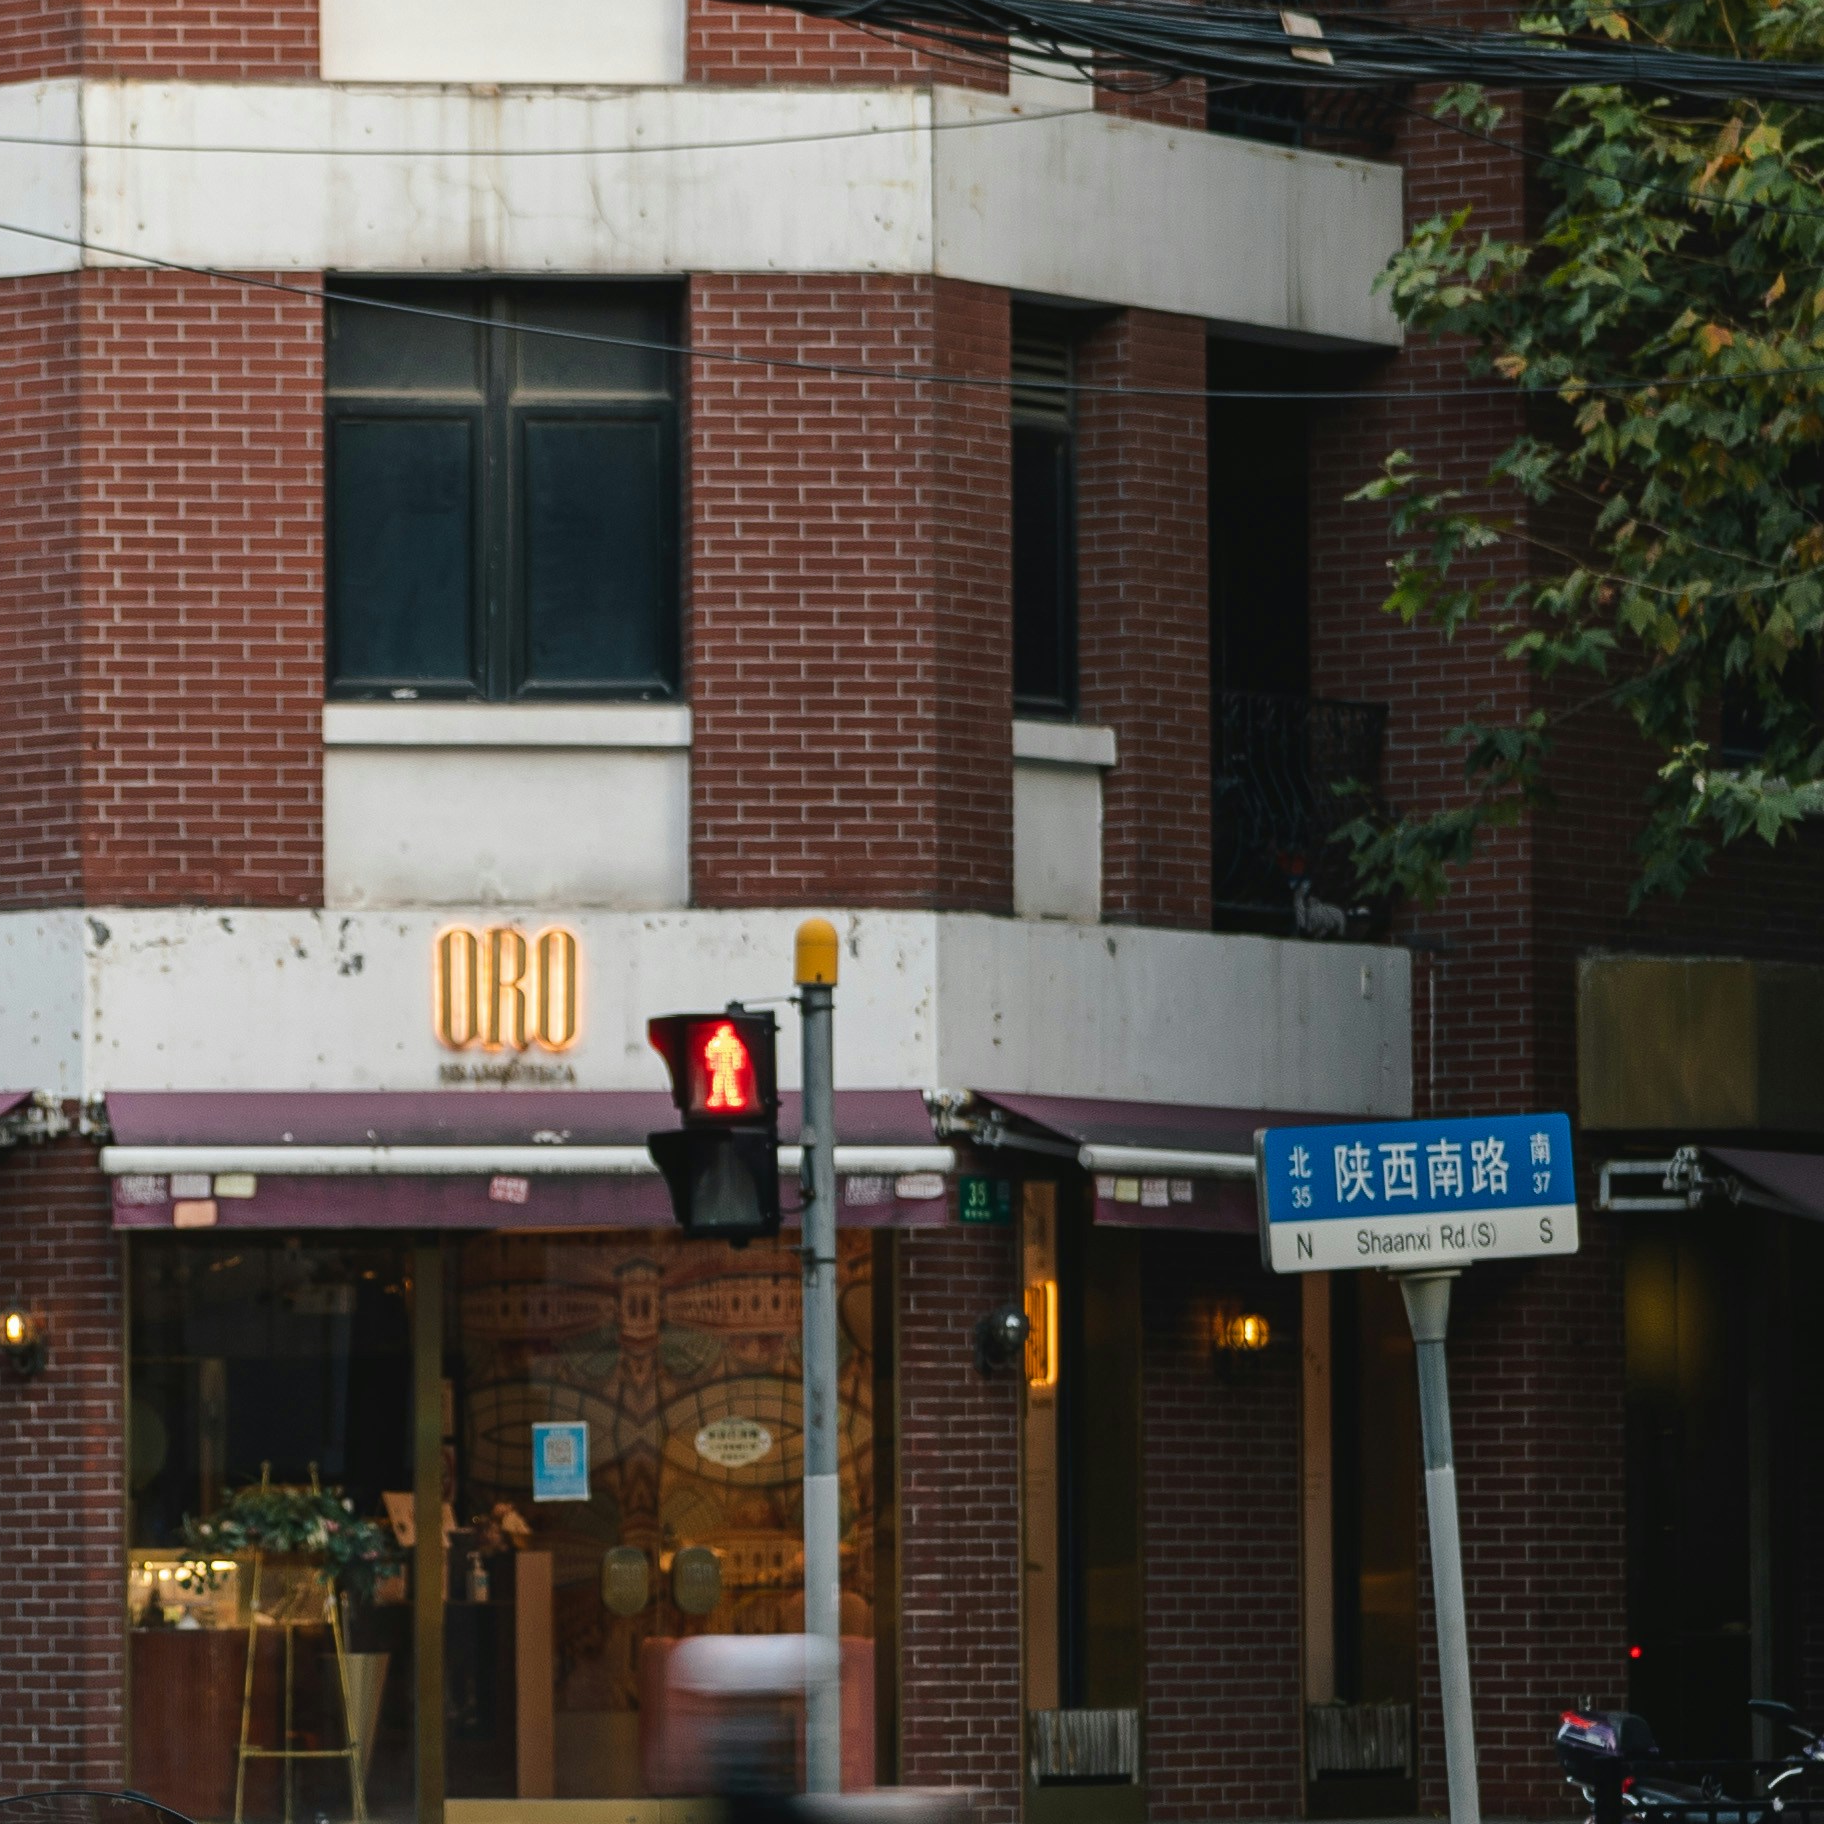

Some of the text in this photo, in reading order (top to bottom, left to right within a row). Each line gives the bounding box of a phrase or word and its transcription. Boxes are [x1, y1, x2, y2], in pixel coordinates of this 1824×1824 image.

[440, 928, 577, 1051] ORO
[1288, 1132, 1552, 1204] 北 陕西南路 南
[1291, 1170, 1552, 1210] 35 37
[1295, 1215, 1554, 1260] N Shaanxi Rd.(S) S
